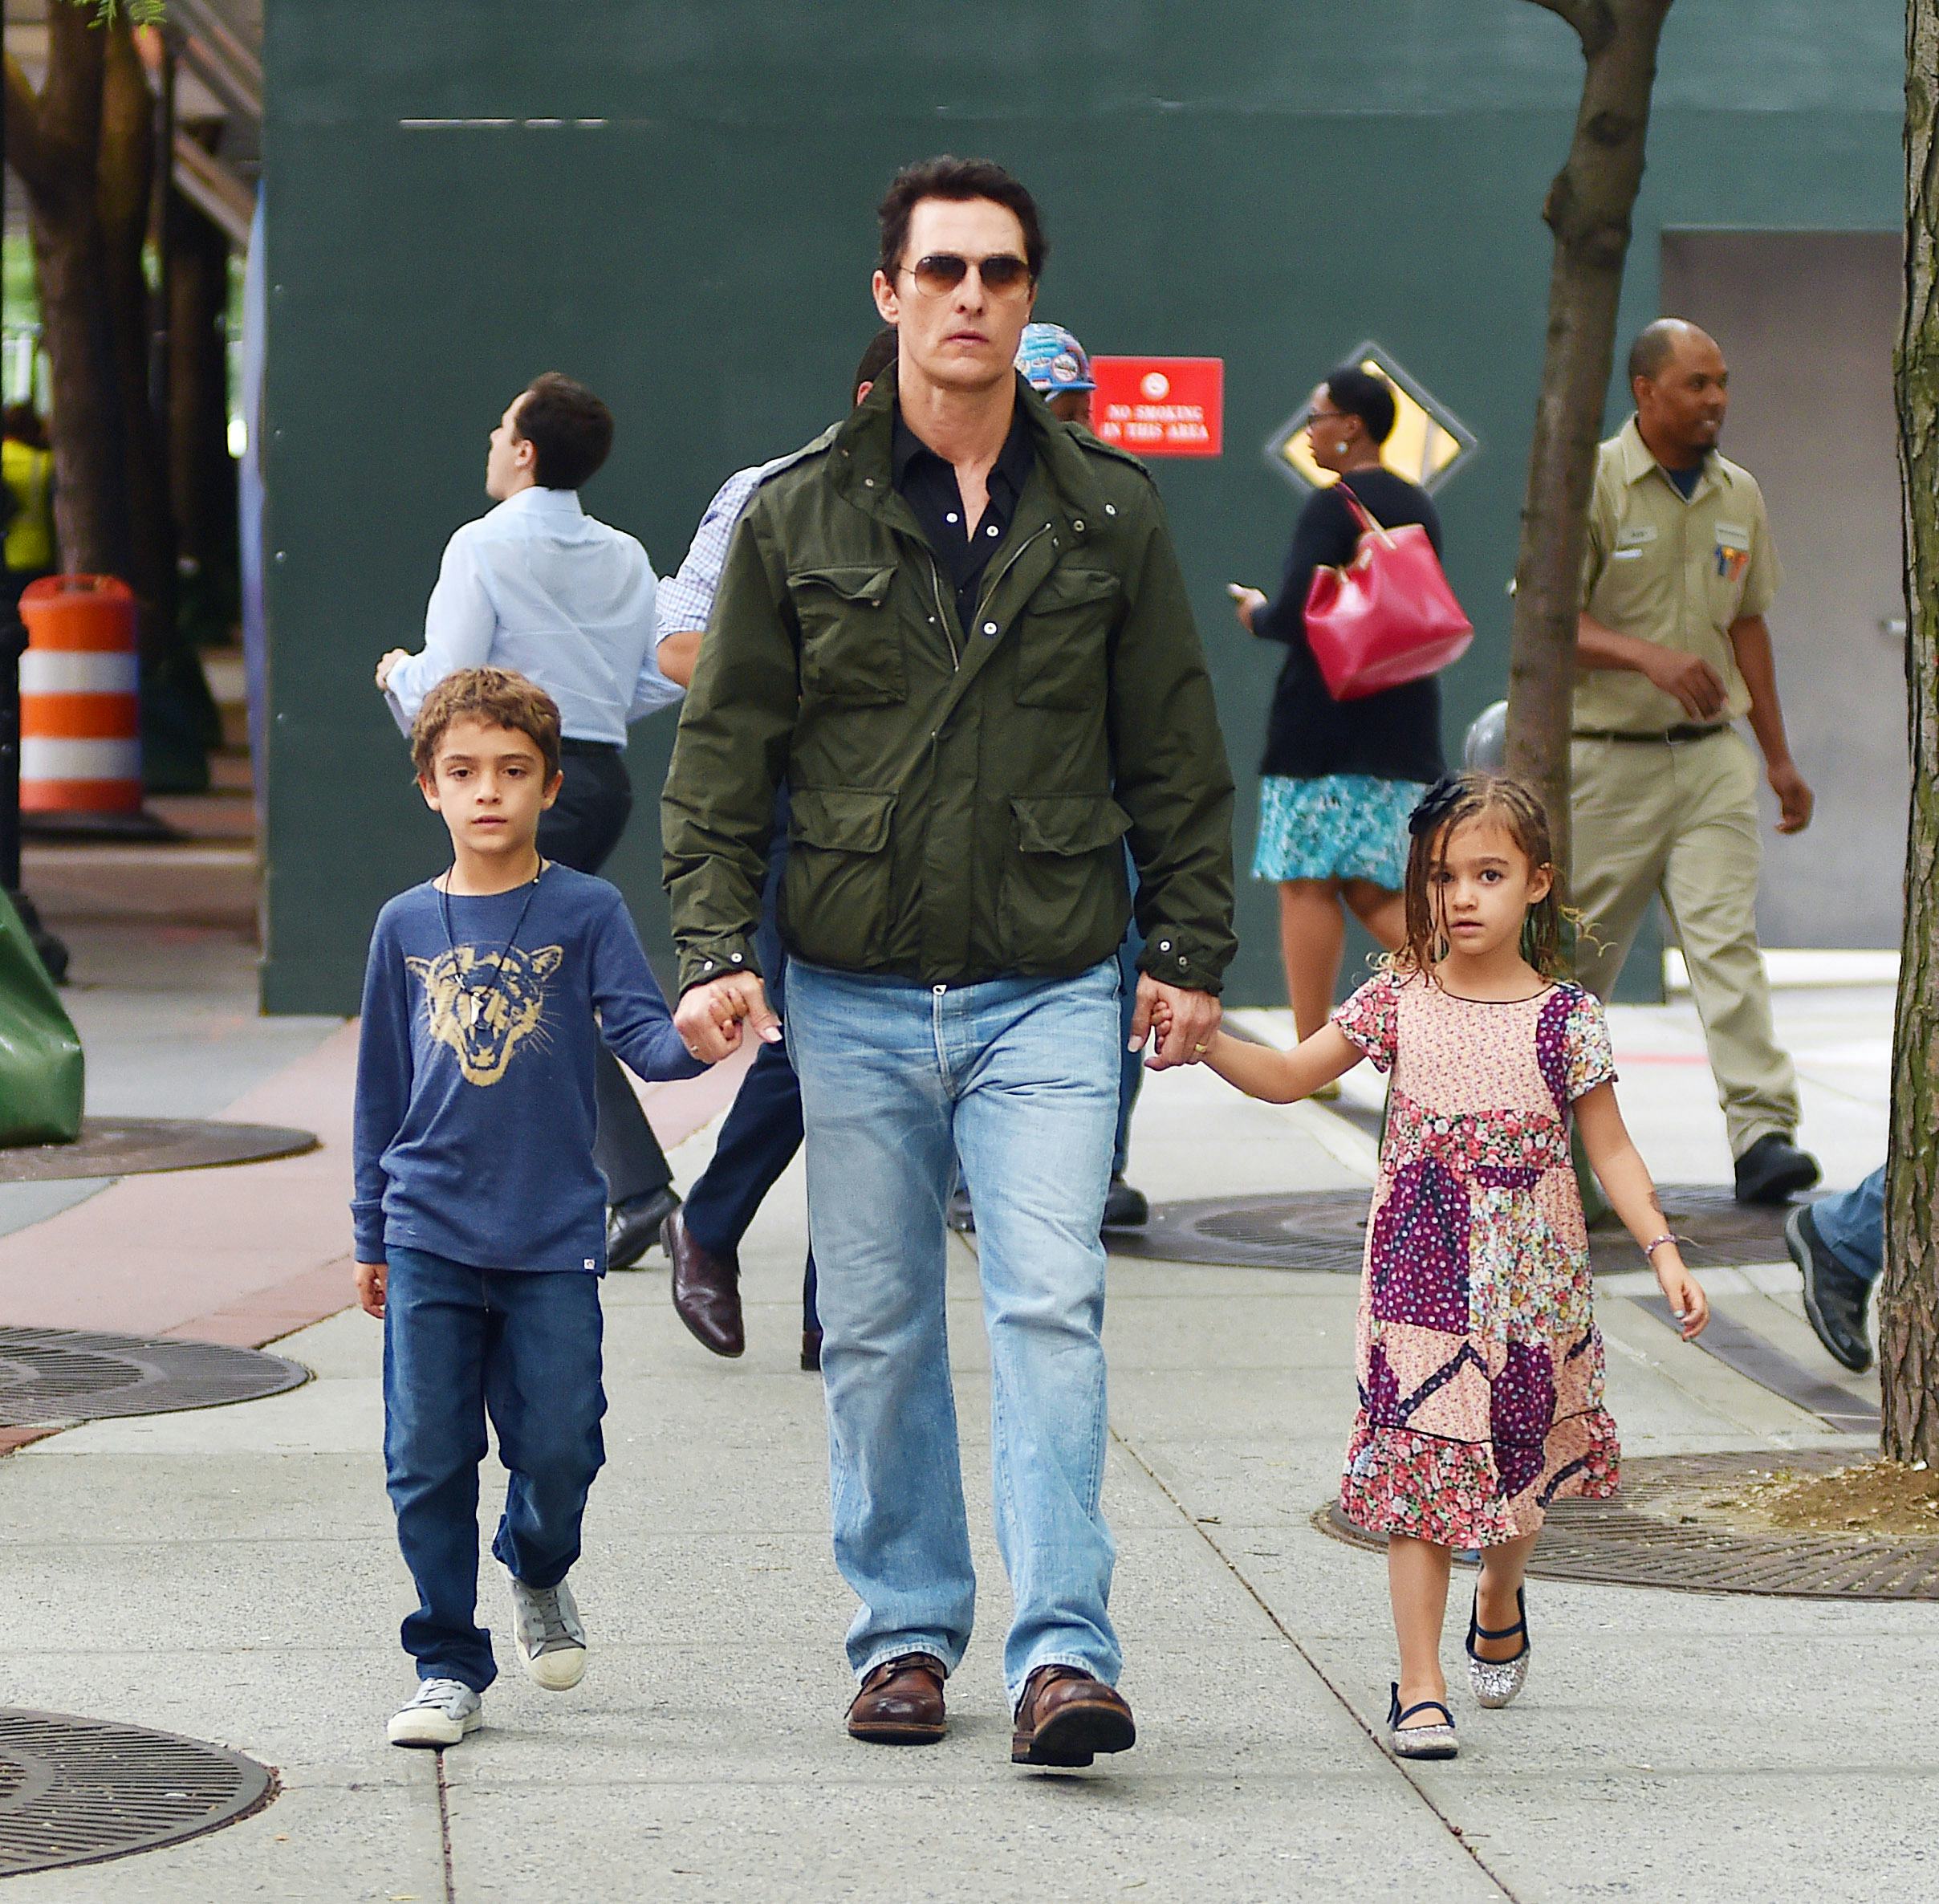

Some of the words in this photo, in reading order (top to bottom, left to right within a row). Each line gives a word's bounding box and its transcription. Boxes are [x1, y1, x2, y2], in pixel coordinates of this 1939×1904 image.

[1108, 404, 1131, 421] NO
[1134, 405, 1203, 422] SMOKING
[1102, 422, 1121, 437] IN
[1125, 422, 1163, 439] THIS
[1167, 423, 1209, 440] AREA
